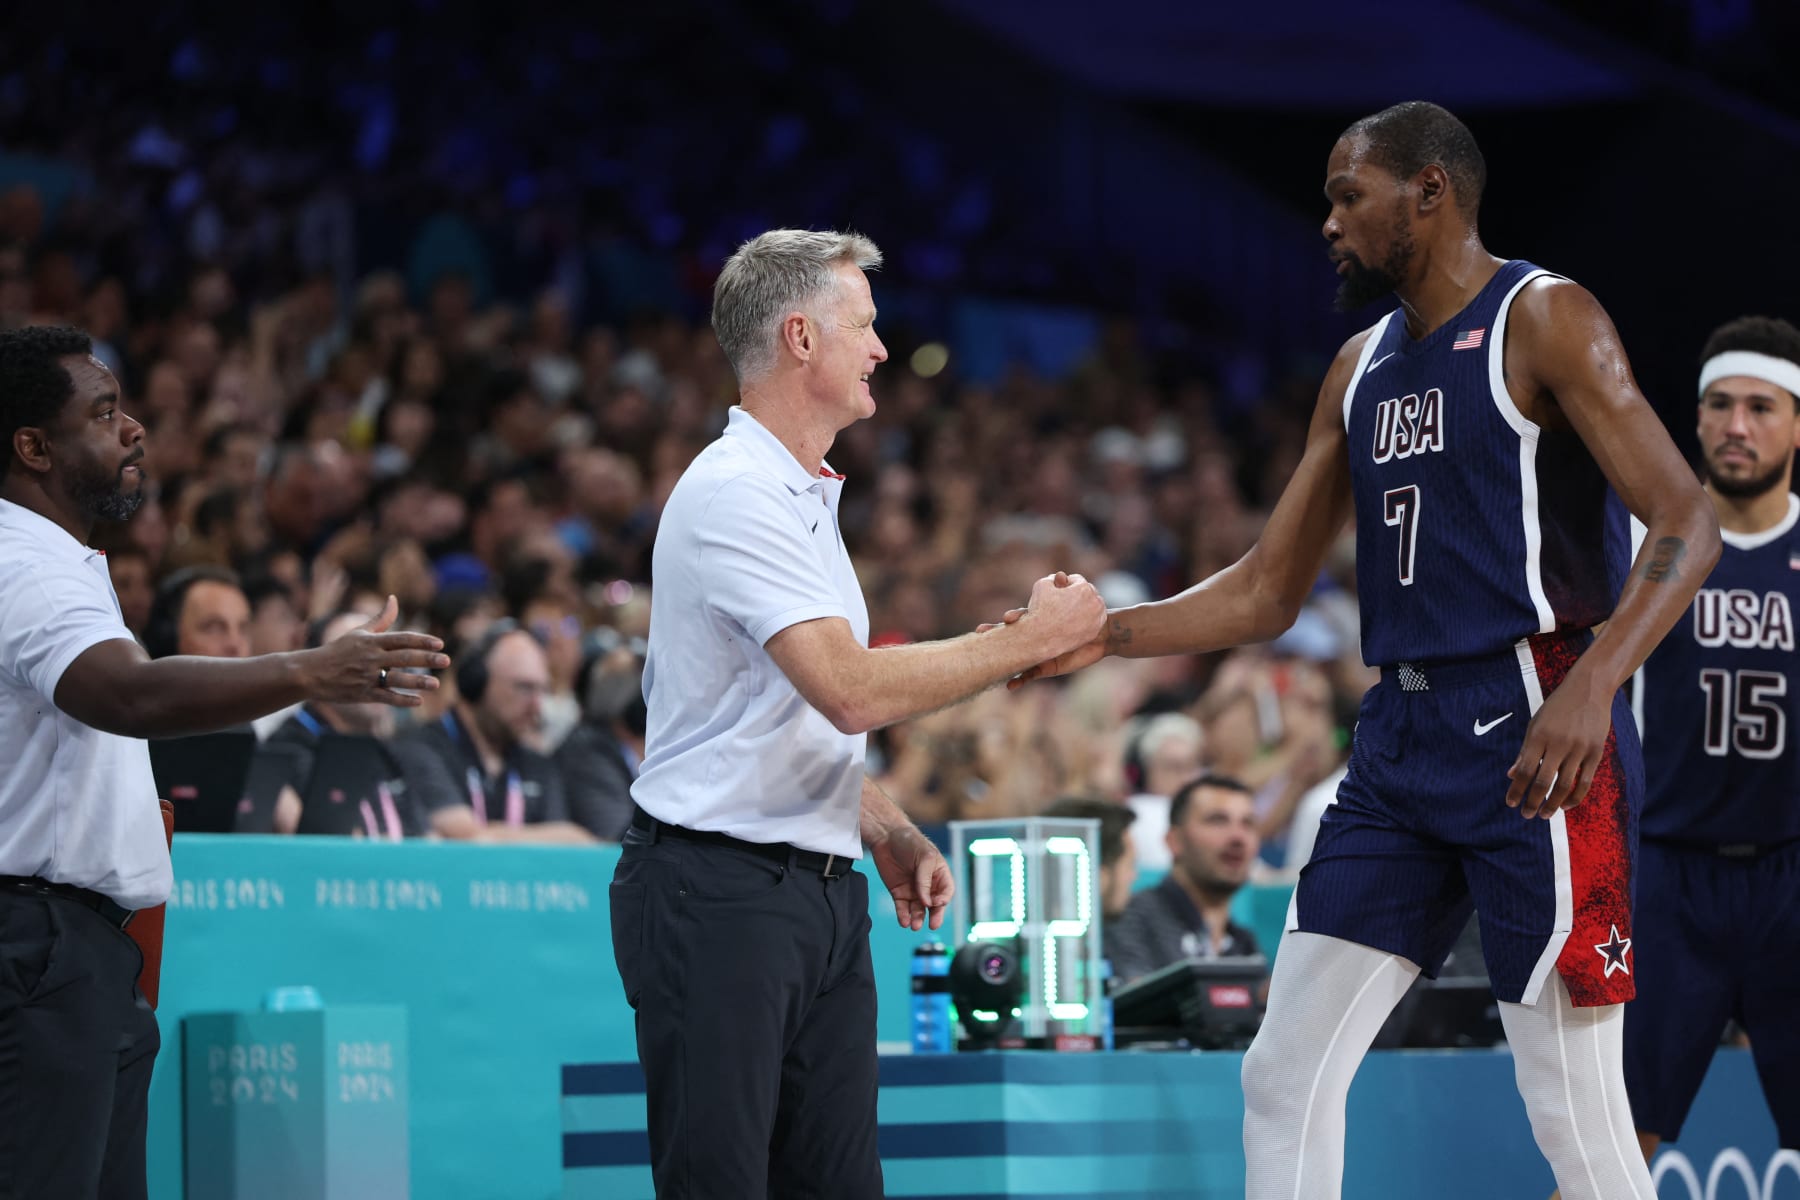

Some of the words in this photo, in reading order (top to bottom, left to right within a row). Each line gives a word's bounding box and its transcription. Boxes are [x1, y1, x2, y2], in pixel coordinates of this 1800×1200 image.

[1373, 388, 1443, 465] USA
[1384, 484, 1420, 586] 7
[1694, 588, 1795, 651] USA
[1700, 668, 1787, 759] 15
[168, 878, 218, 910] ARIS
[223, 878, 284, 910] 2024
[315, 879, 379, 910] PARIS
[385, 879, 442, 911] 2024
[208, 1042, 297, 1073] PARIS
[338, 1041, 393, 1070] PARIS
[209, 1073, 298, 1104] 2024
[339, 1072, 395, 1104] 2024
